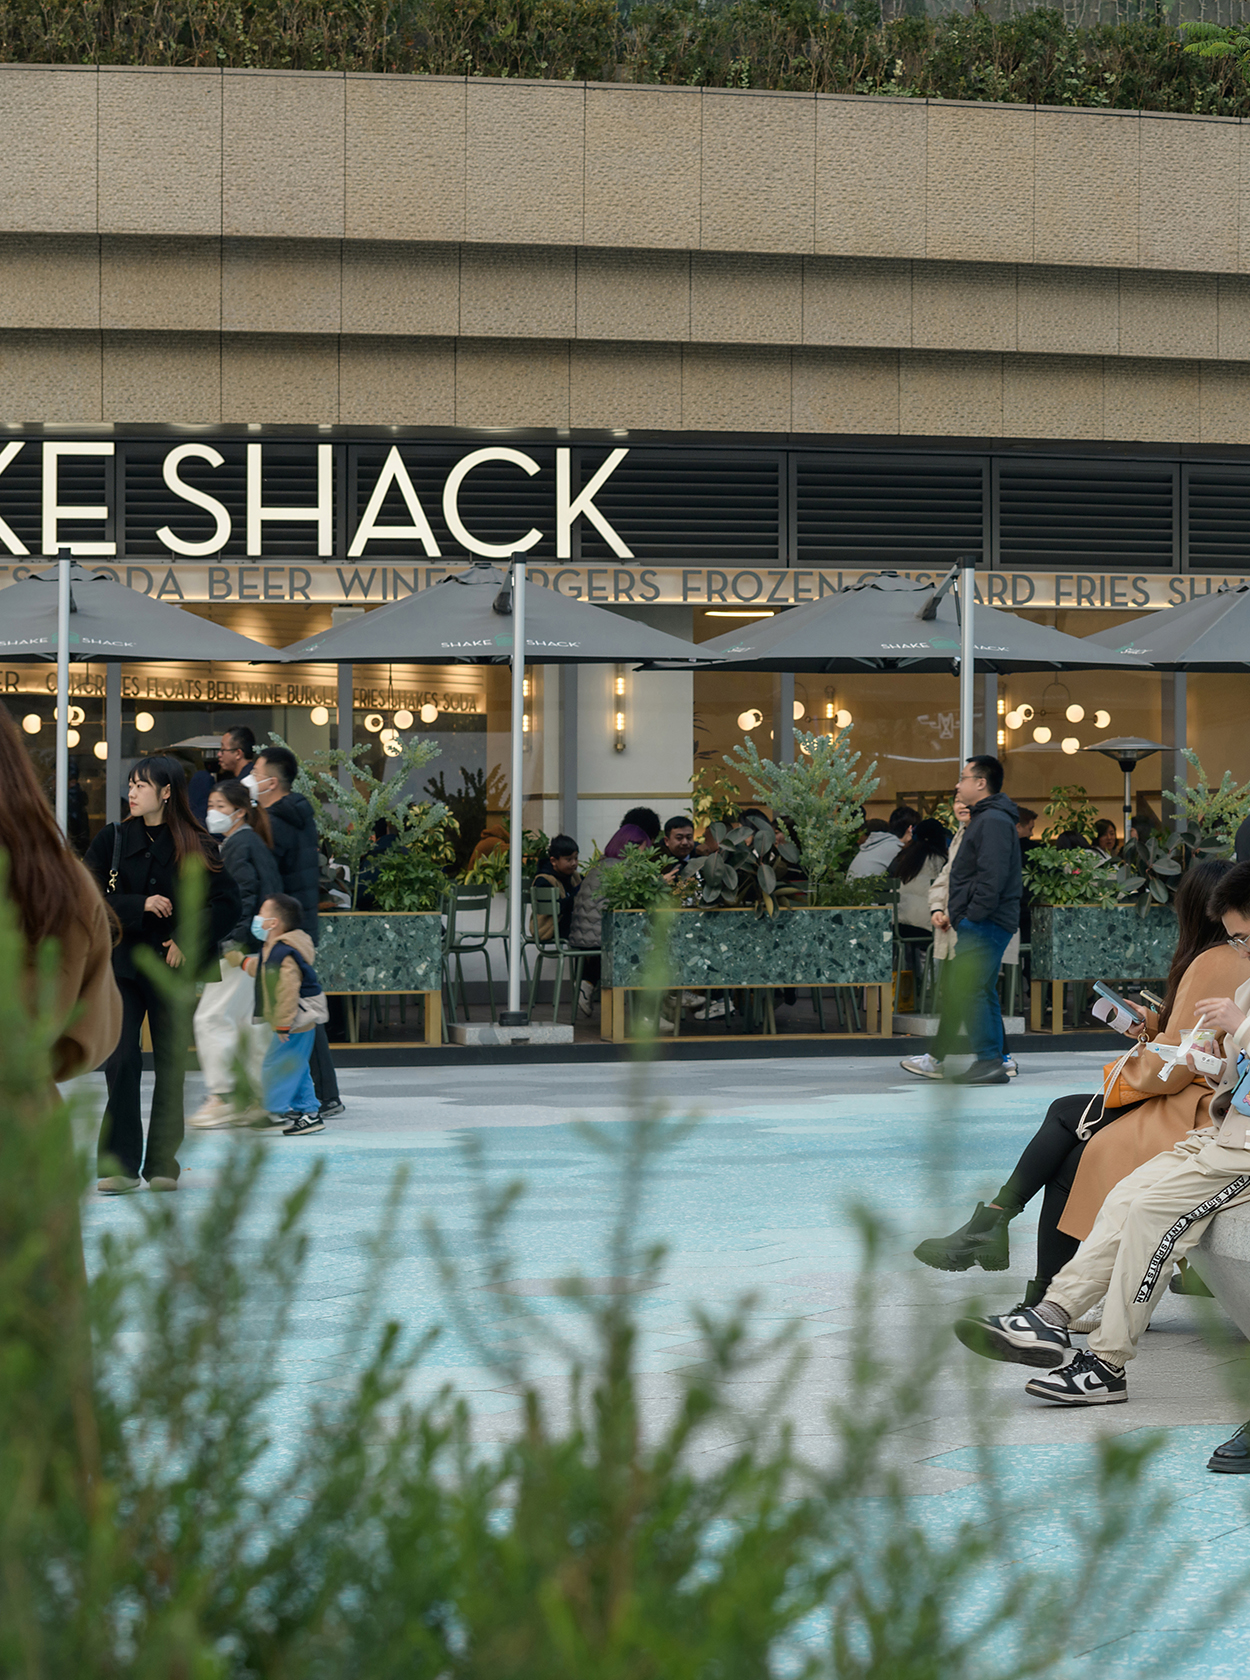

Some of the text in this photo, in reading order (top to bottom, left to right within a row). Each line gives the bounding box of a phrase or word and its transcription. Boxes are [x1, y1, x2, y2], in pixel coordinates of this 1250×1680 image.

[156, 443, 634, 558] SHACK
[208, 566, 311, 600] BEER
[682, 569, 843, 602] FROZEN
[1055, 574, 1150, 607] FRIES
[0, 637, 134, 648] SHAKE SHACK
[441, 639, 580, 648] SHAKE SHACK
[881, 642, 930, 650] SHAKE
[146, 677, 203, 700] FLOATS
[287, 684, 338, 706] BURGER
[443, 692, 477, 712] SODA
[1223, 1176, 1245, 1196] ANTA
[1148, 1221, 1183, 1279] ANTA SPORTS
